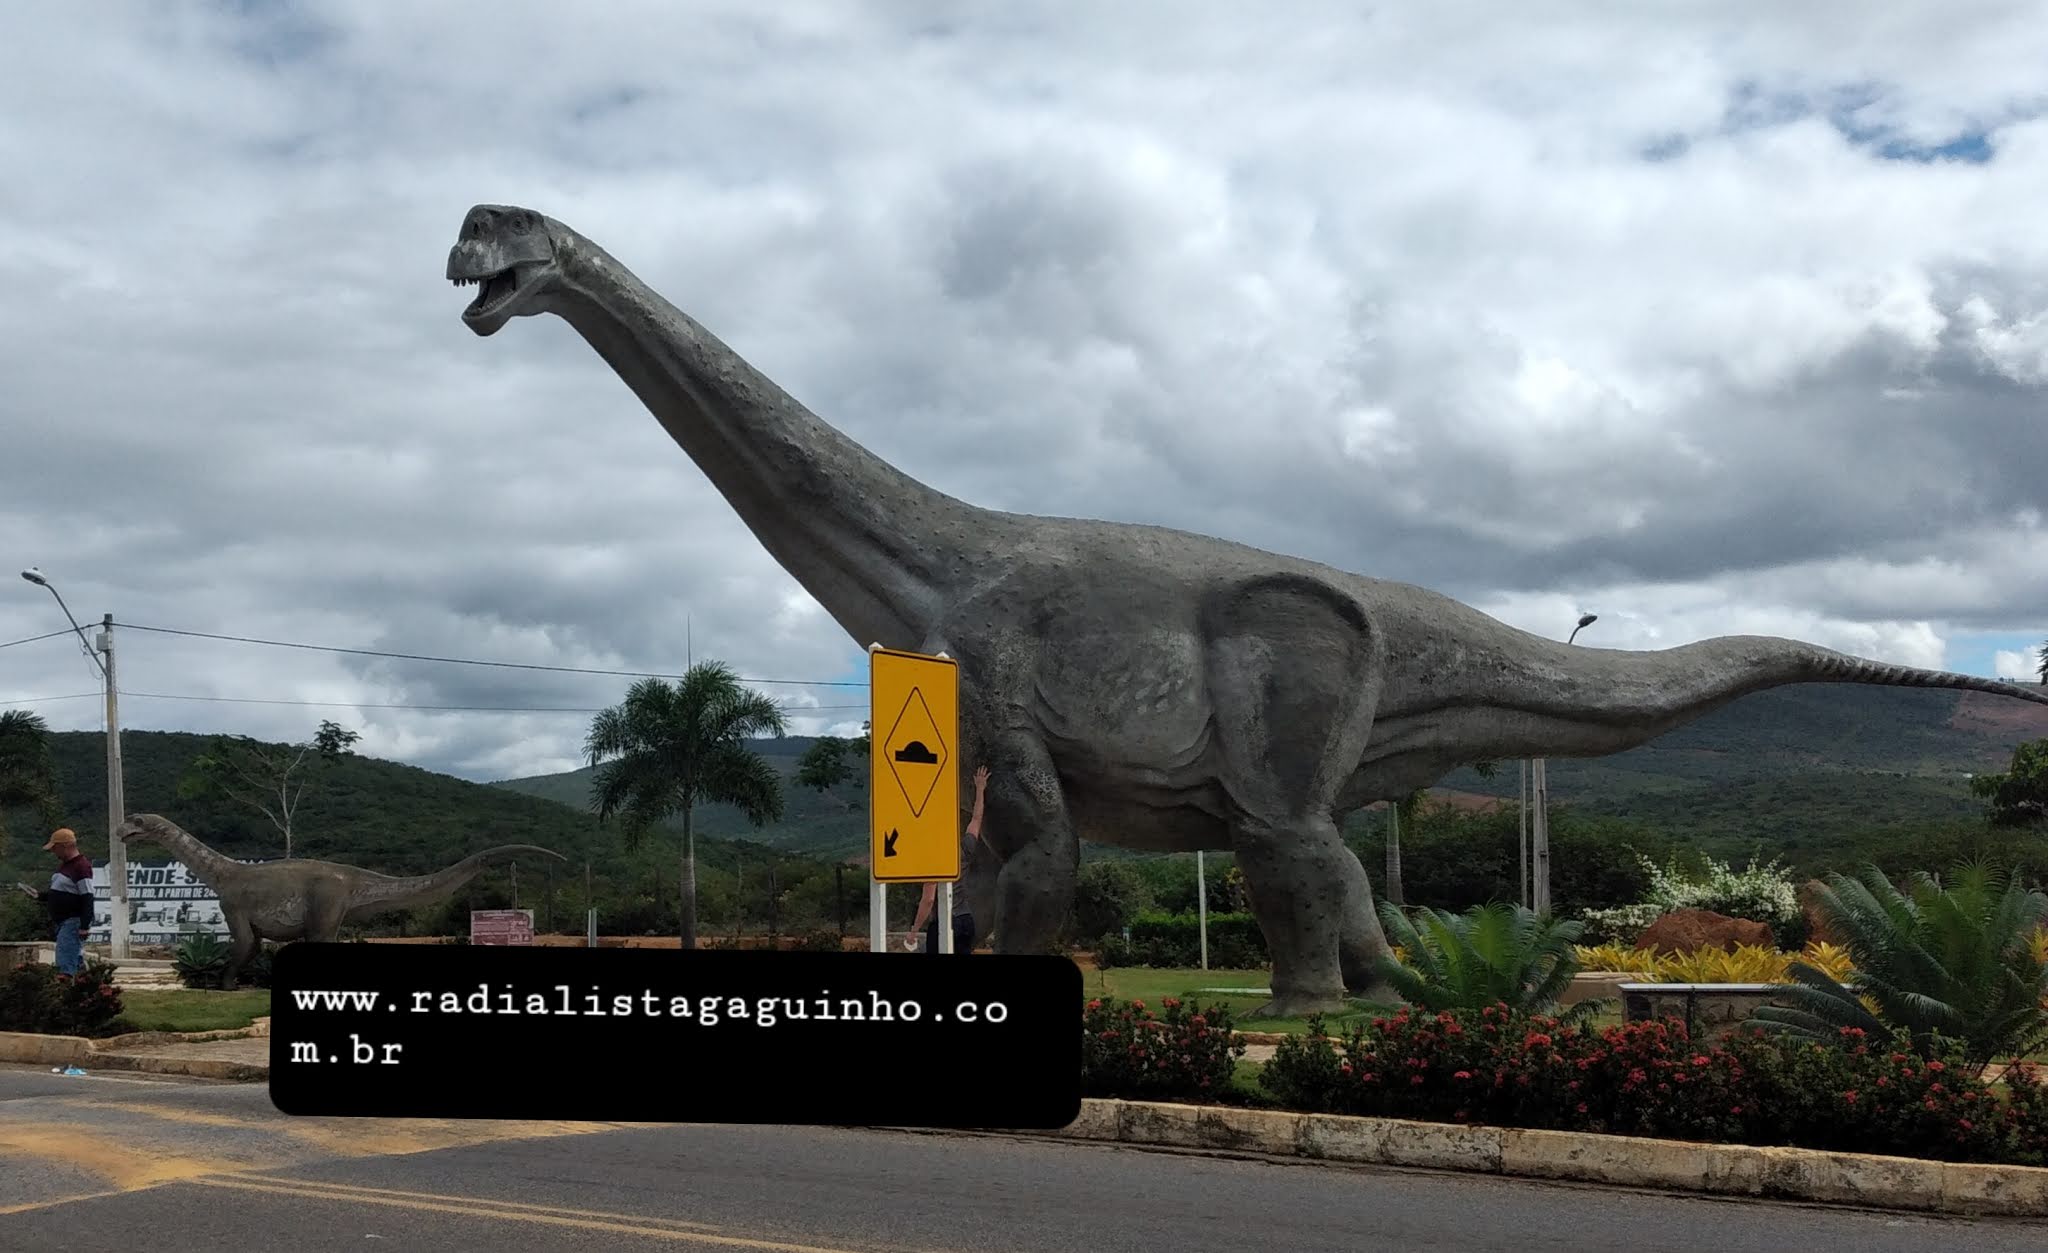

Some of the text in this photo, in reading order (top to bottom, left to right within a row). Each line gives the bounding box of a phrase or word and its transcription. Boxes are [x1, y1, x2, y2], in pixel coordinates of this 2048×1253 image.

[127, 869, 206, 885] ENDE-S
[158, 888, 164, 898] A
[165, 887, 192, 898] PARTIR
[192, 887, 203, 898] DE
